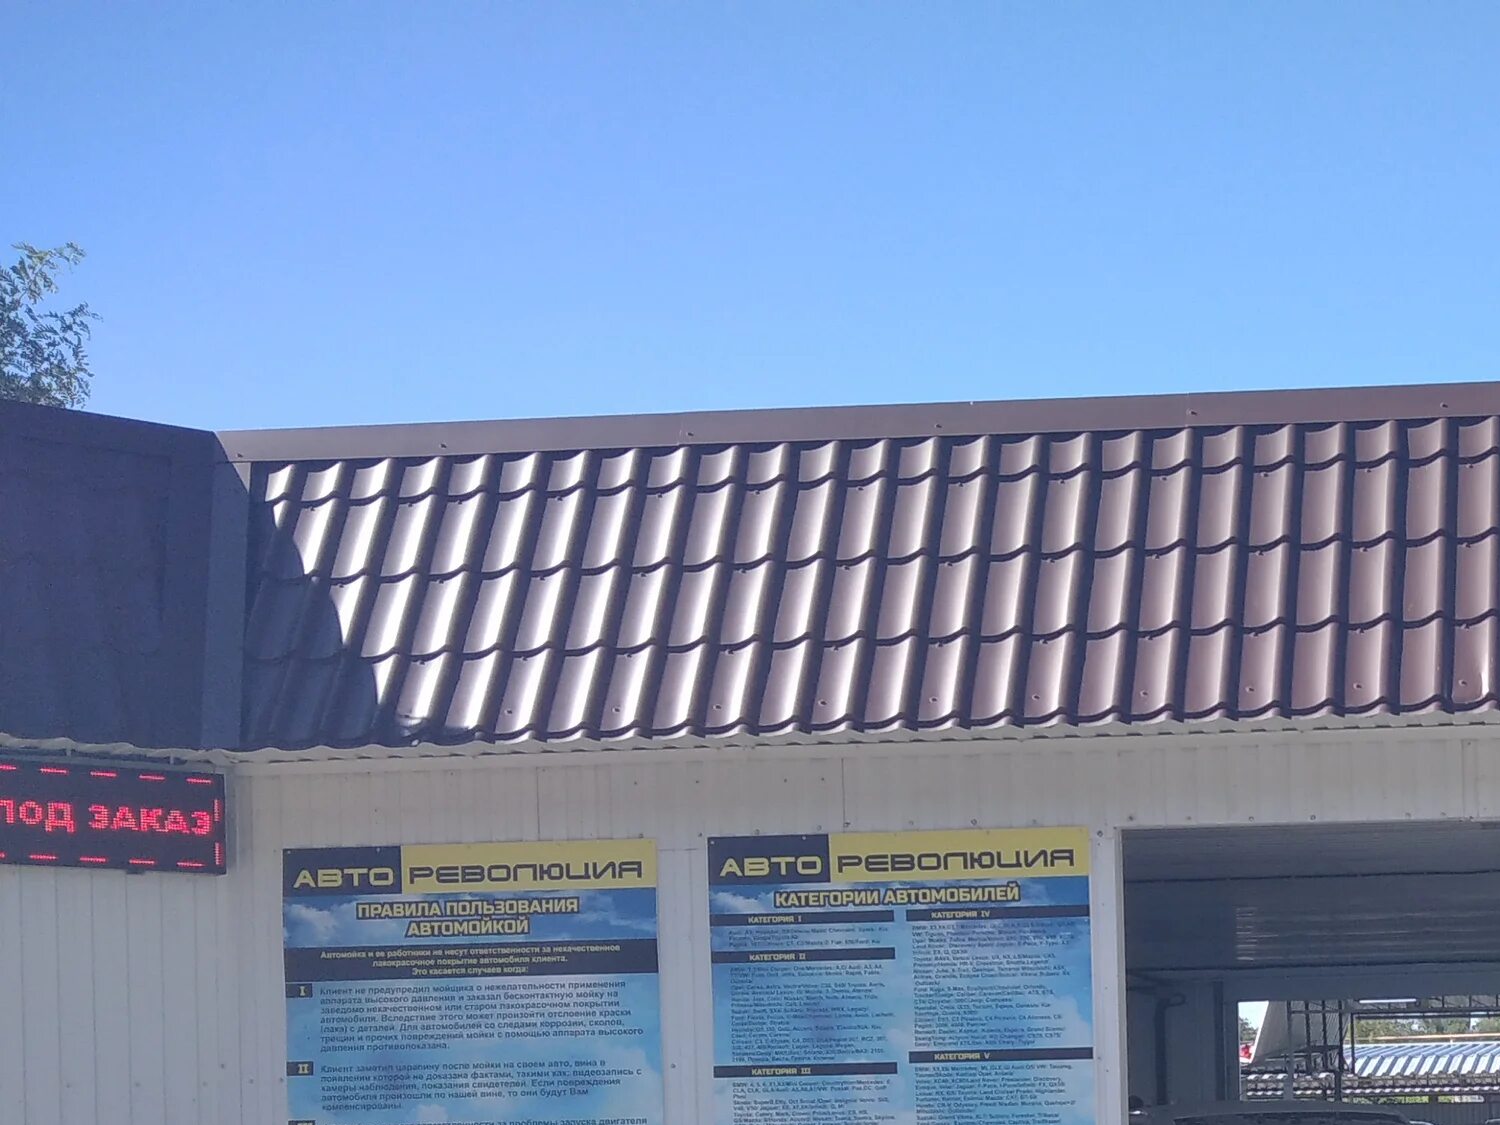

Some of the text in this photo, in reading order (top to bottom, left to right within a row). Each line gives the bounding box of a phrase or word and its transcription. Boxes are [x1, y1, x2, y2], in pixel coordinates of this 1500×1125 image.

[88, 804, 211, 835] ЗАКАЗ
[720, 848, 1074, 876] АВТО РЕВОЛЮЦИЯ
[293, 860, 642, 888] АВТО РЕВОЛЮЦИЯ
[775, 883, 1020, 909] КАТЕГОРИИ АВТОМОБИЛЕЙ
[357, 898, 579, 919] ПРАВИЛА ПОЛЬЗОВАНИЯ
[930, 909, 990, 918] КАТЕГОРИЯ IV
[747, 914, 801, 923] КАТЕГОРИЯ I
[407, 917, 529, 937] АВТОМОЙКОЙ
[748, 952, 805, 961] КАТЕГОРИЯ II
[299, 985, 305, 996] I
[933, 1051, 990, 1060] КАТЕГОРИЯ V
[751, 1066, 811, 1075] КАТЕГОРИЯ III
